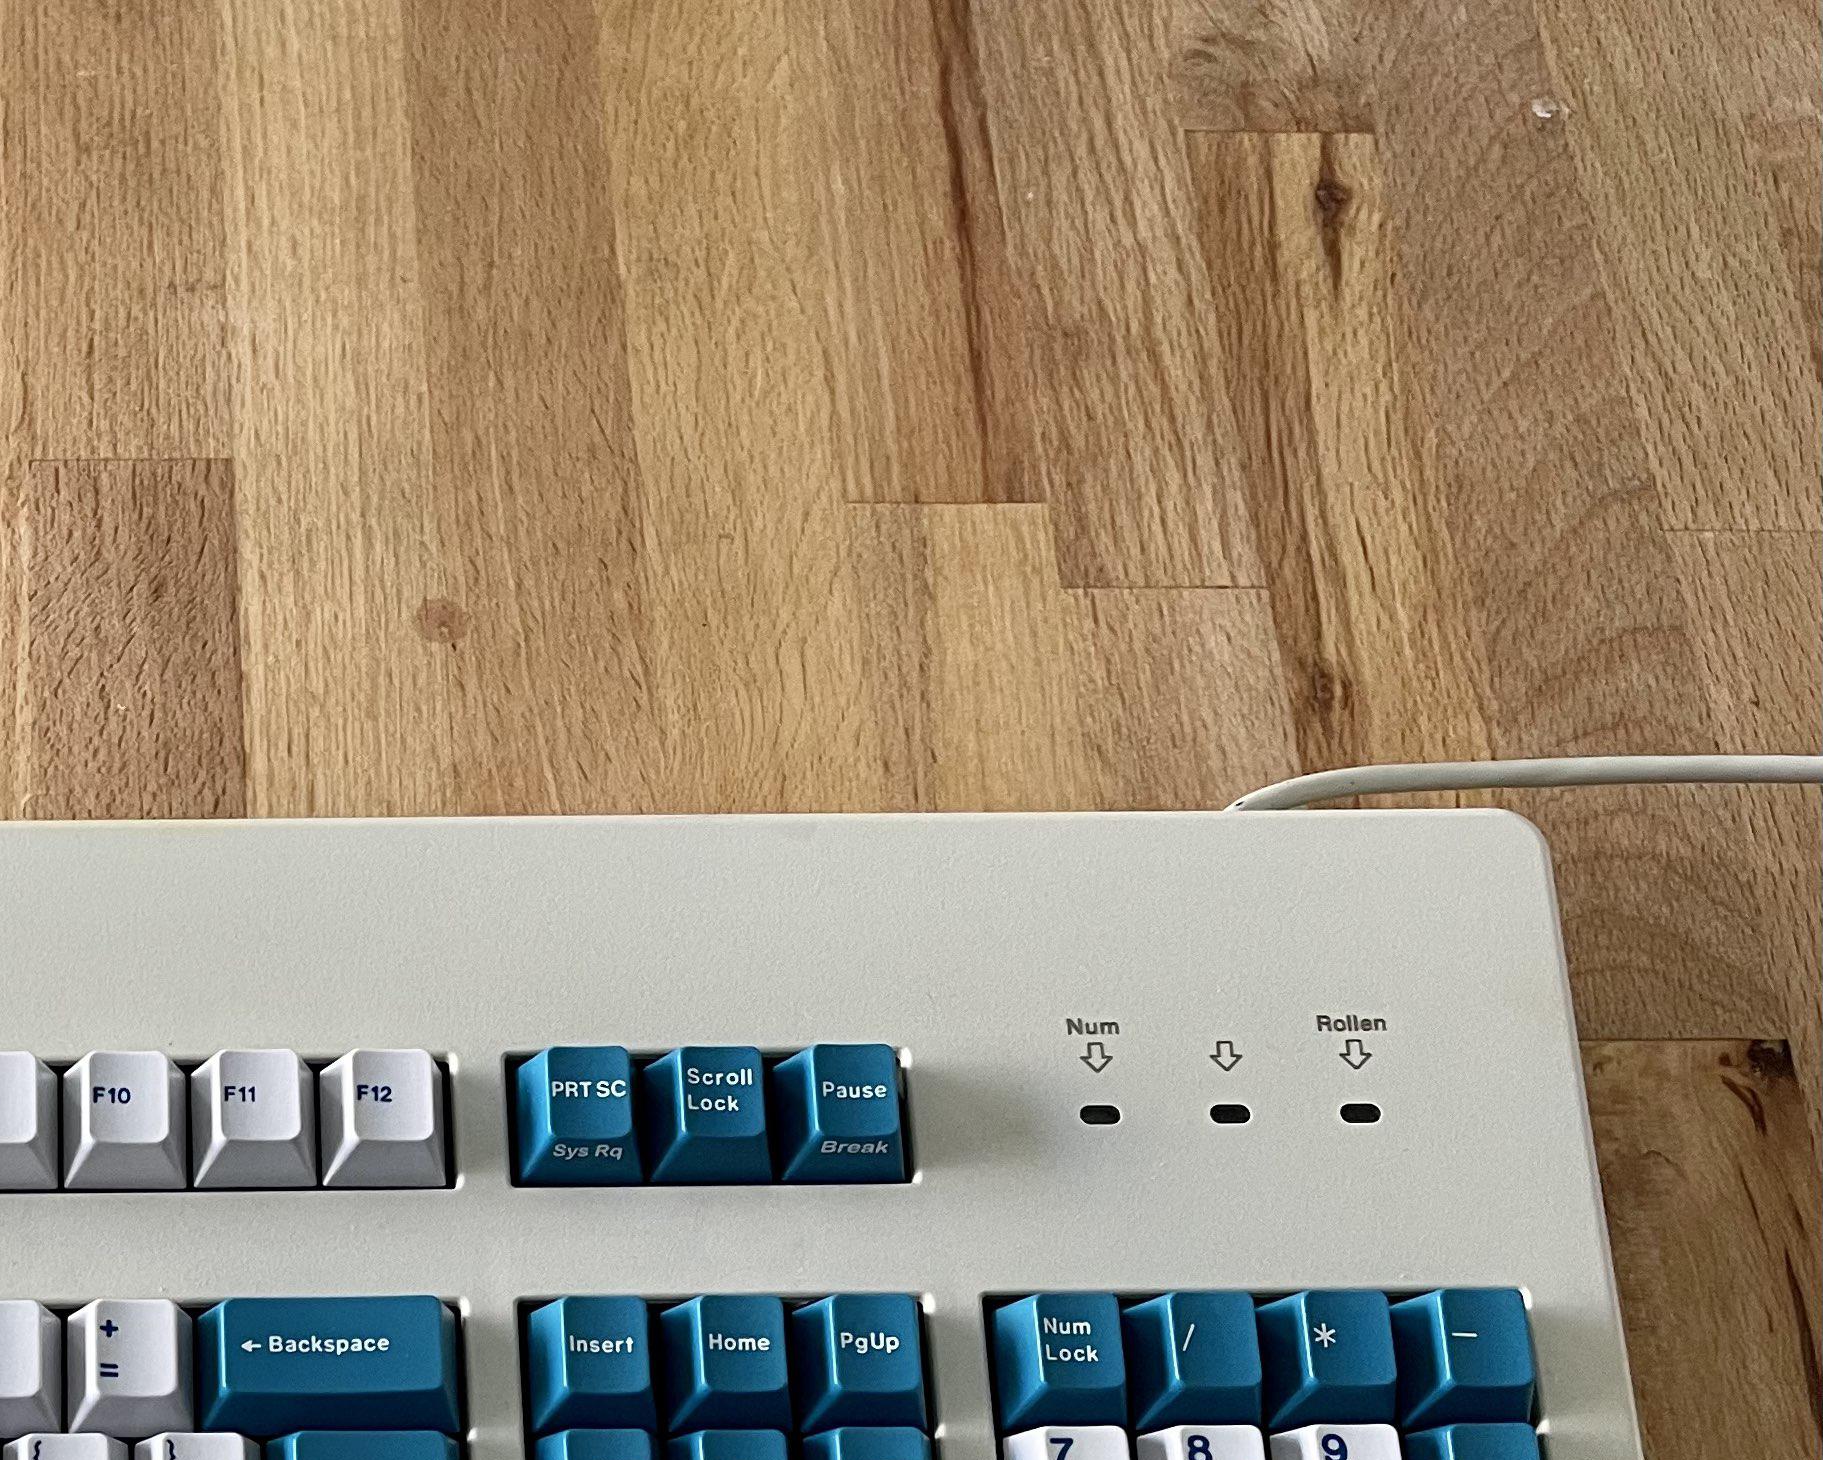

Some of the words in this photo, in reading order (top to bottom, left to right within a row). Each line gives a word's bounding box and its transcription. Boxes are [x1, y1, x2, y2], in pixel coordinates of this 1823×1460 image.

[1066, 1018, 1119, 1035] Num
[1317, 1015, 1387, 1031] Rollen
[688, 1068, 752, 1085] Scroll
[93, 1087, 131, 1104] F10
[224, 1086, 255, 1102] F11
[357, 1085, 392, 1102] F12
[552, 1082, 591, 1097] PRT
[597, 1080, 626, 1097] SC
[823, 1082, 886, 1098] Pause
[688, 1095, 738, 1111] Lock
[553, 1144, 588, 1160] Sys
[595, 1145, 622, 1160] Rq
[821, 1141, 888, 1153] Break
[100, 1320, 118, 1337] +
[1044, 1318, 1090, 1334] Num
[269, 1336, 389, 1355] Backspace
[570, 1336, 633, 1353] Insert
[709, 1334, 770, 1350] Home
[1183, 1324, 1194, 1351] /
[1046, 1345, 1098, 1361] Lock
[99, 1362, 119, 1378] =
